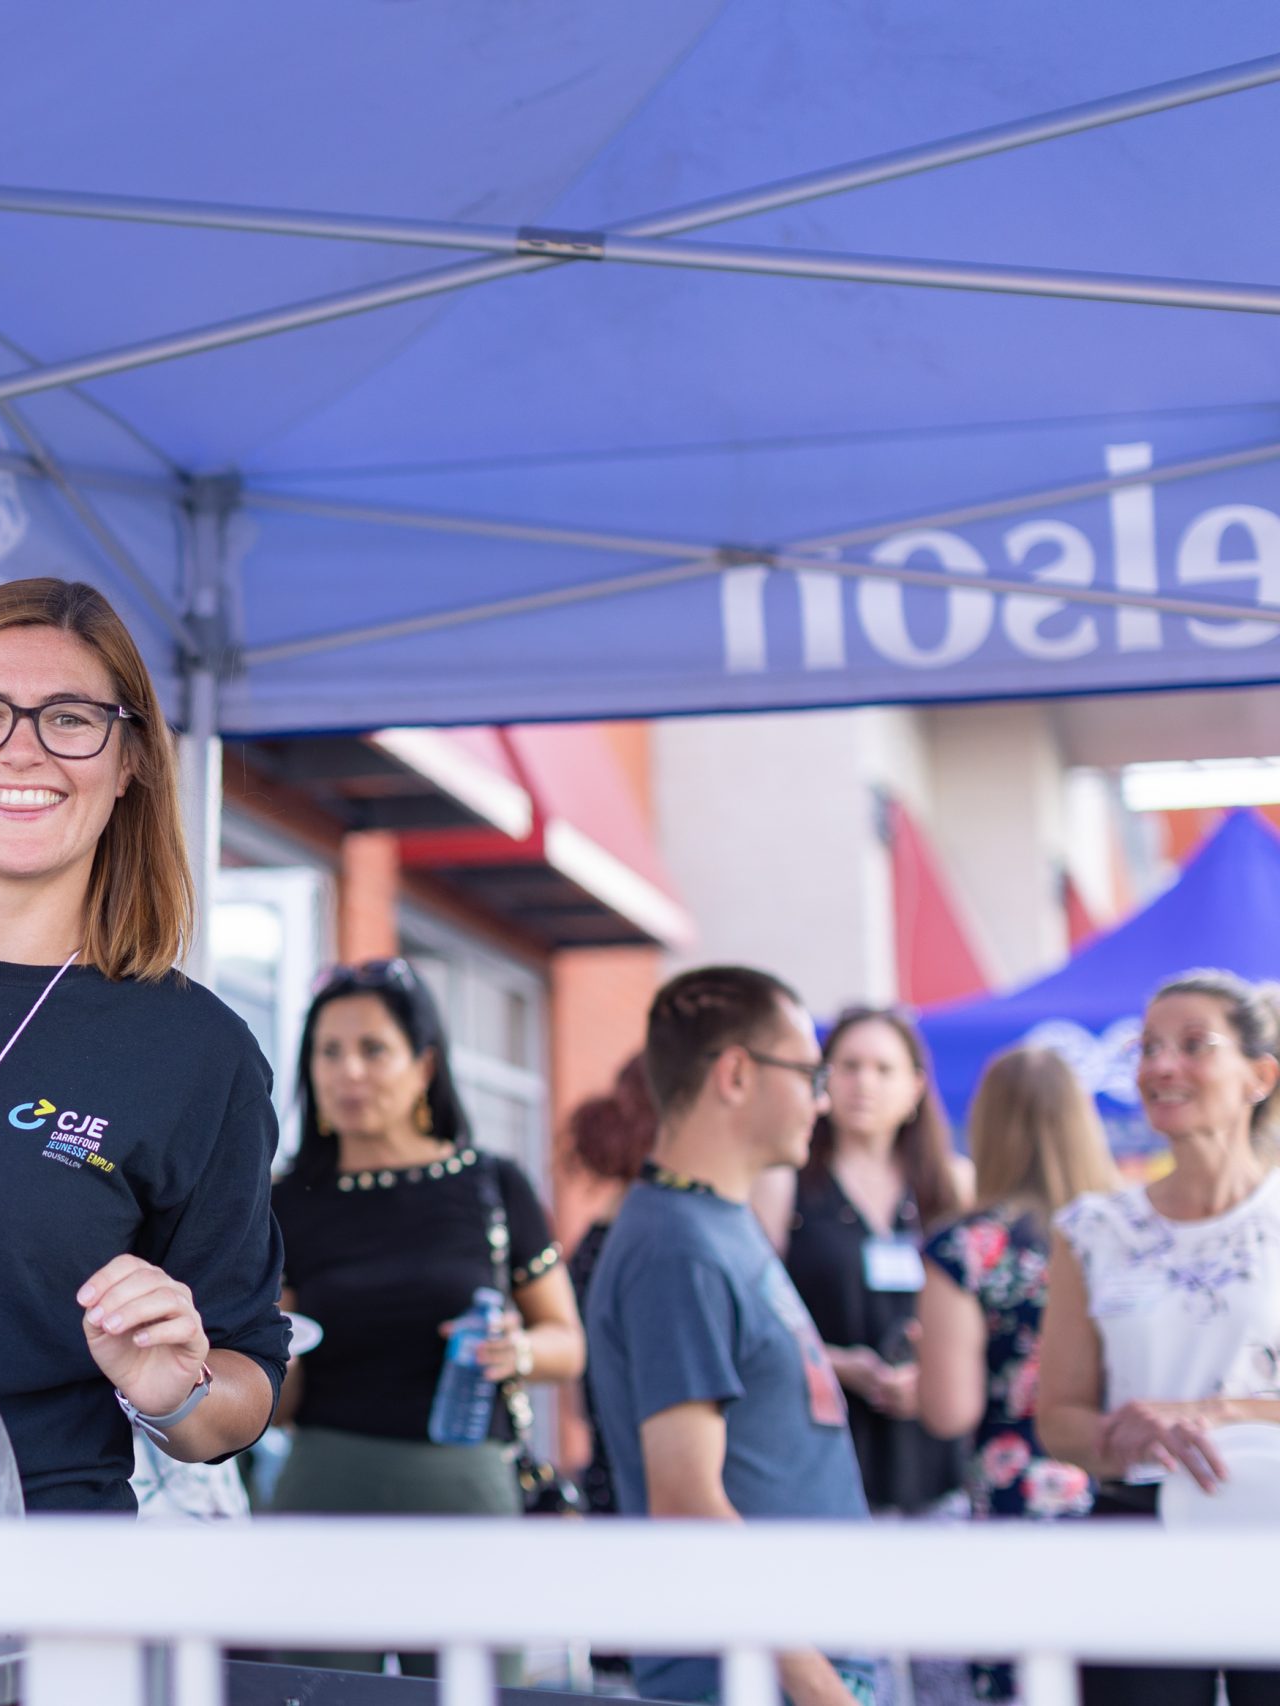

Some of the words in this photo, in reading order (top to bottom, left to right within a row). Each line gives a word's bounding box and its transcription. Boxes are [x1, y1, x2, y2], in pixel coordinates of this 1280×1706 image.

[57, 1111, 109, 1139] CJE
[46, 1140, 89, 1160] JEUNESSE
[50, 1131, 101, 1152] CARREFOUR
[42, 1150, 82, 1169] ROUSSILLON
